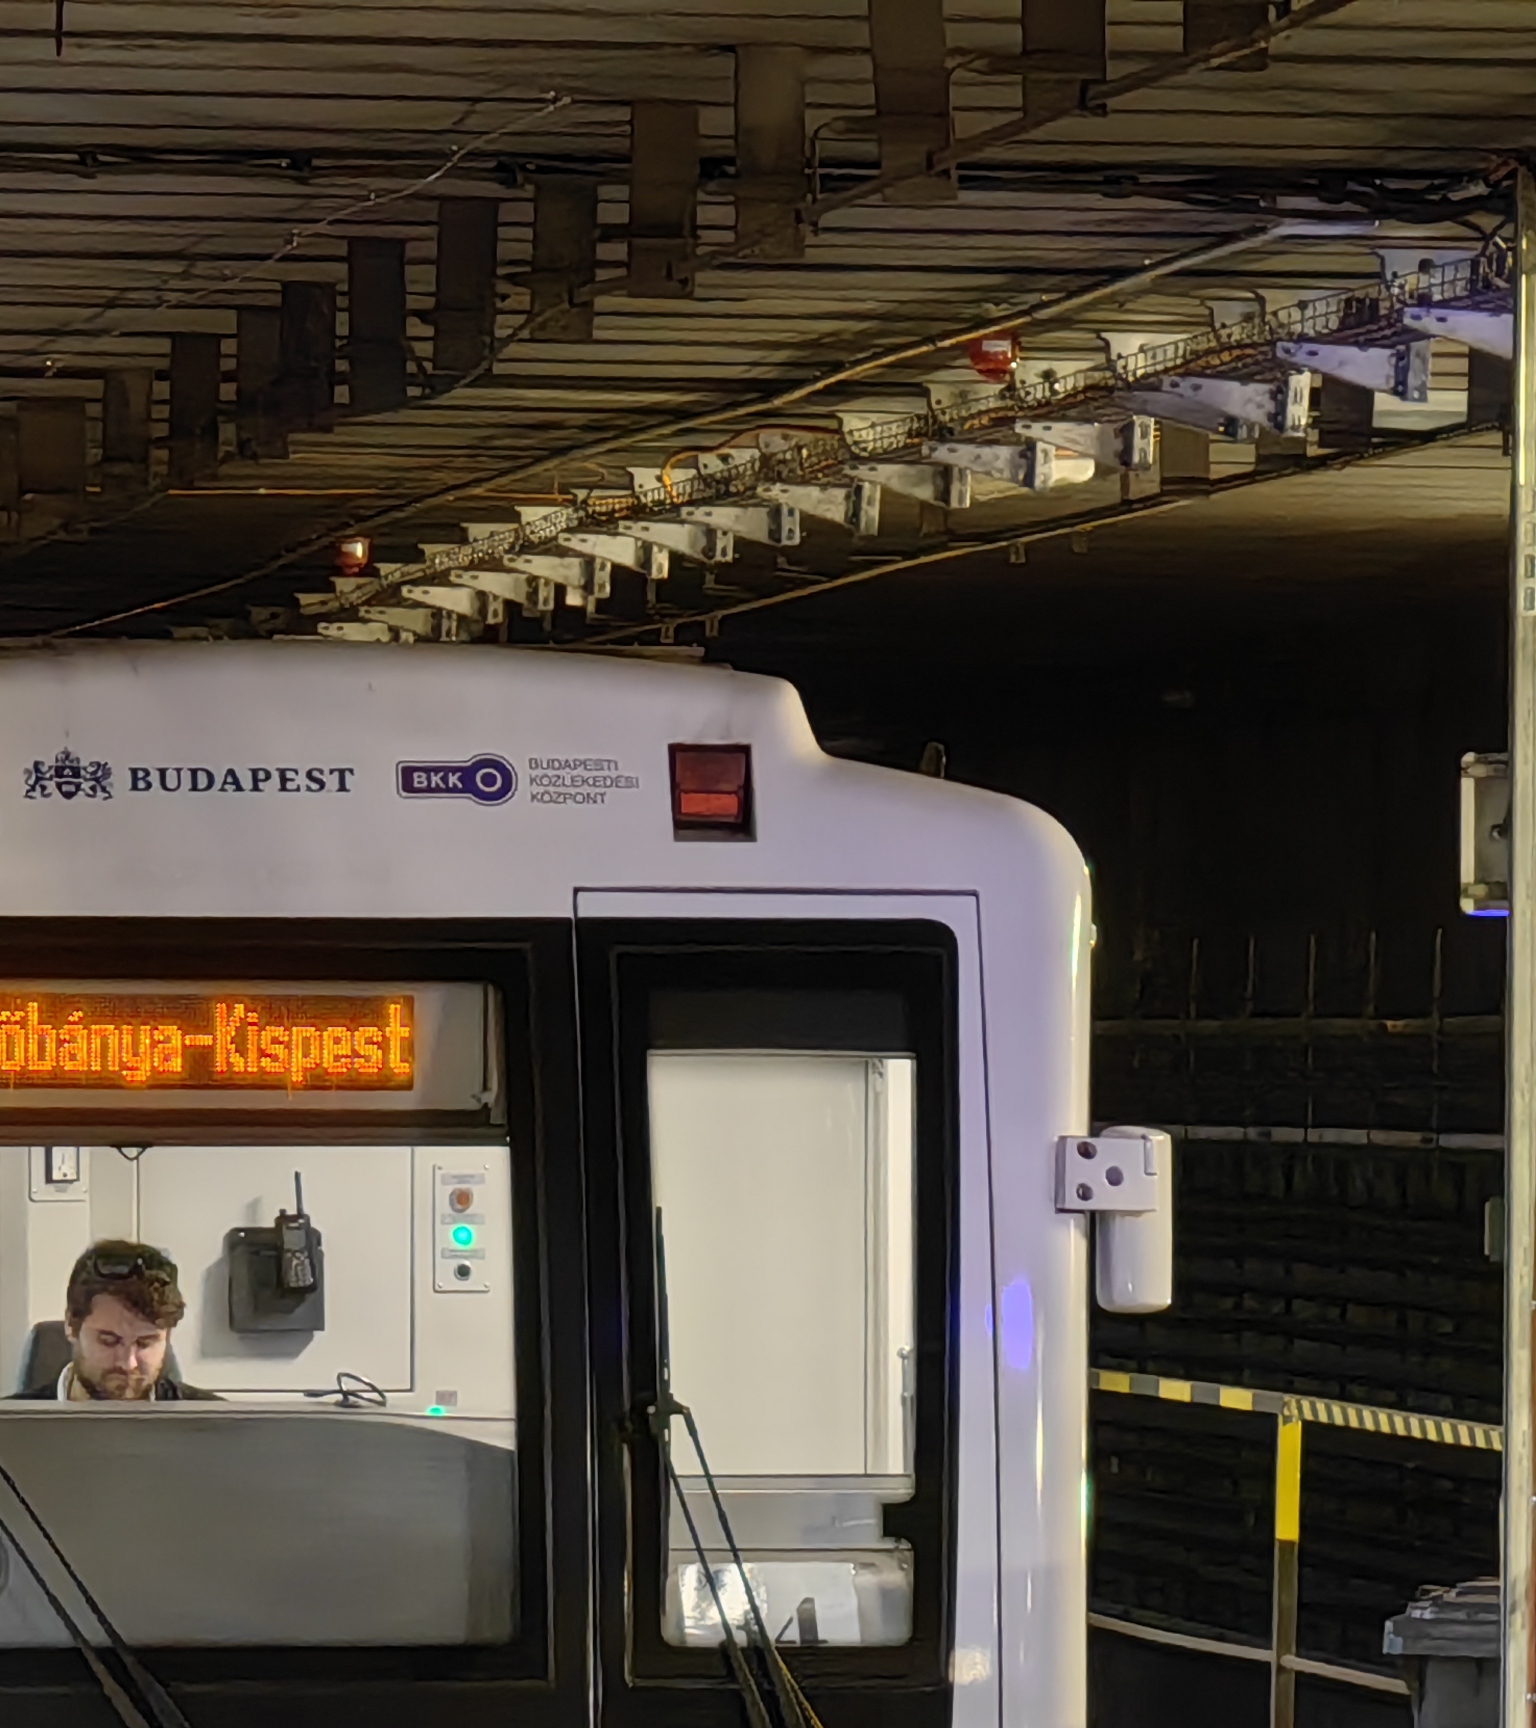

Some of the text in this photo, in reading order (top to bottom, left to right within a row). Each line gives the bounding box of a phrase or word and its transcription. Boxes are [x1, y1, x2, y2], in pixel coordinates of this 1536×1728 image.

[528, 757, 619, 771] BUDAPESTI
[127, 766, 355, 793] BUDAPEST
[413, 771, 463, 789] BKK
